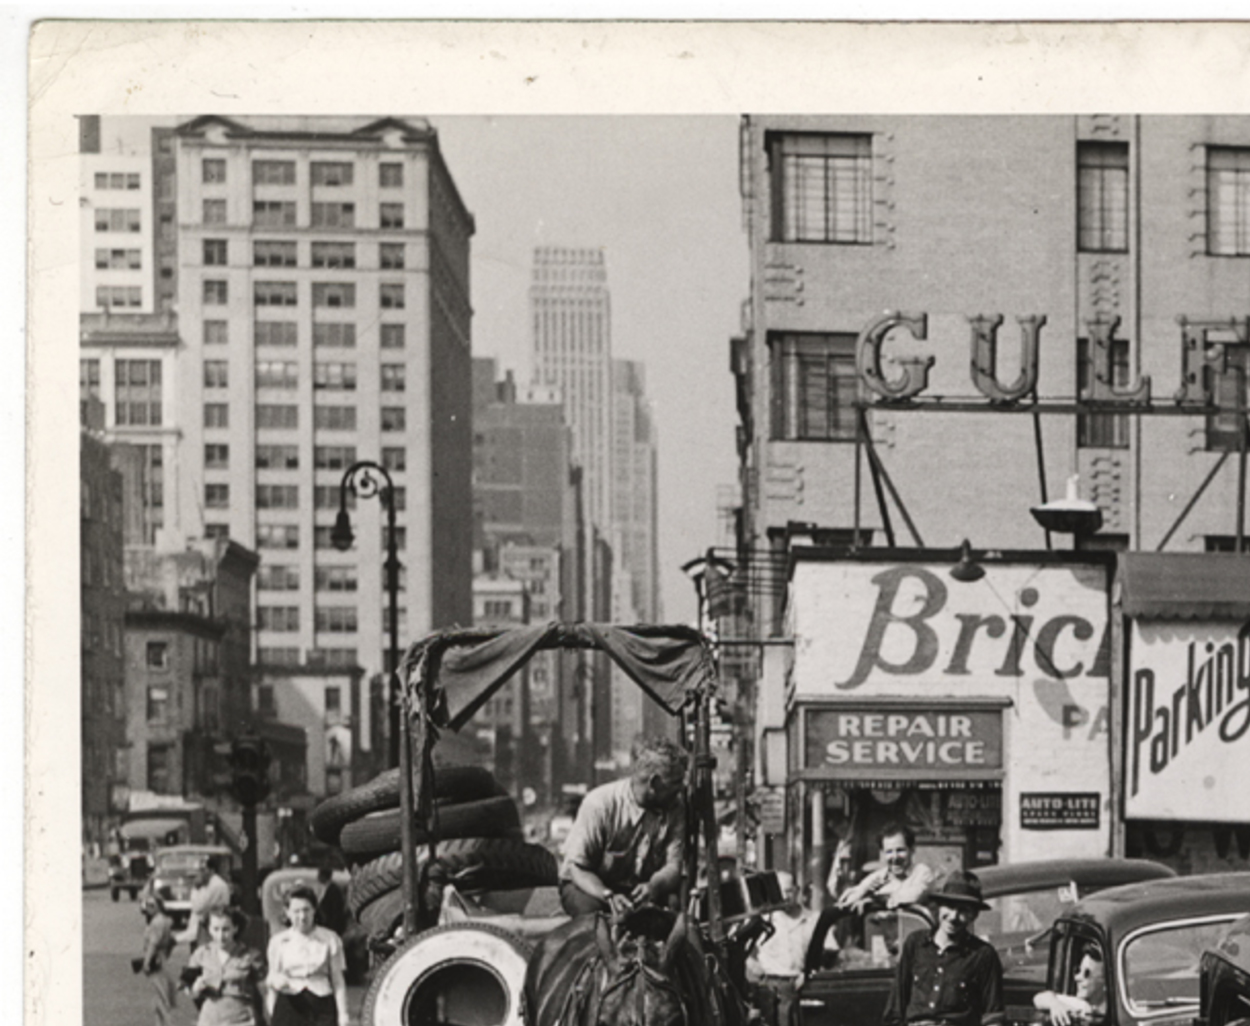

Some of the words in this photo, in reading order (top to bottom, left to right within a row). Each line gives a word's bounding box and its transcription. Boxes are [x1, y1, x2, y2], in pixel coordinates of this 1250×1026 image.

[856, 313, 1250, 407] GULF
[838, 715, 972, 737] REPAIR
[825, 741, 985, 763] SERVICE
